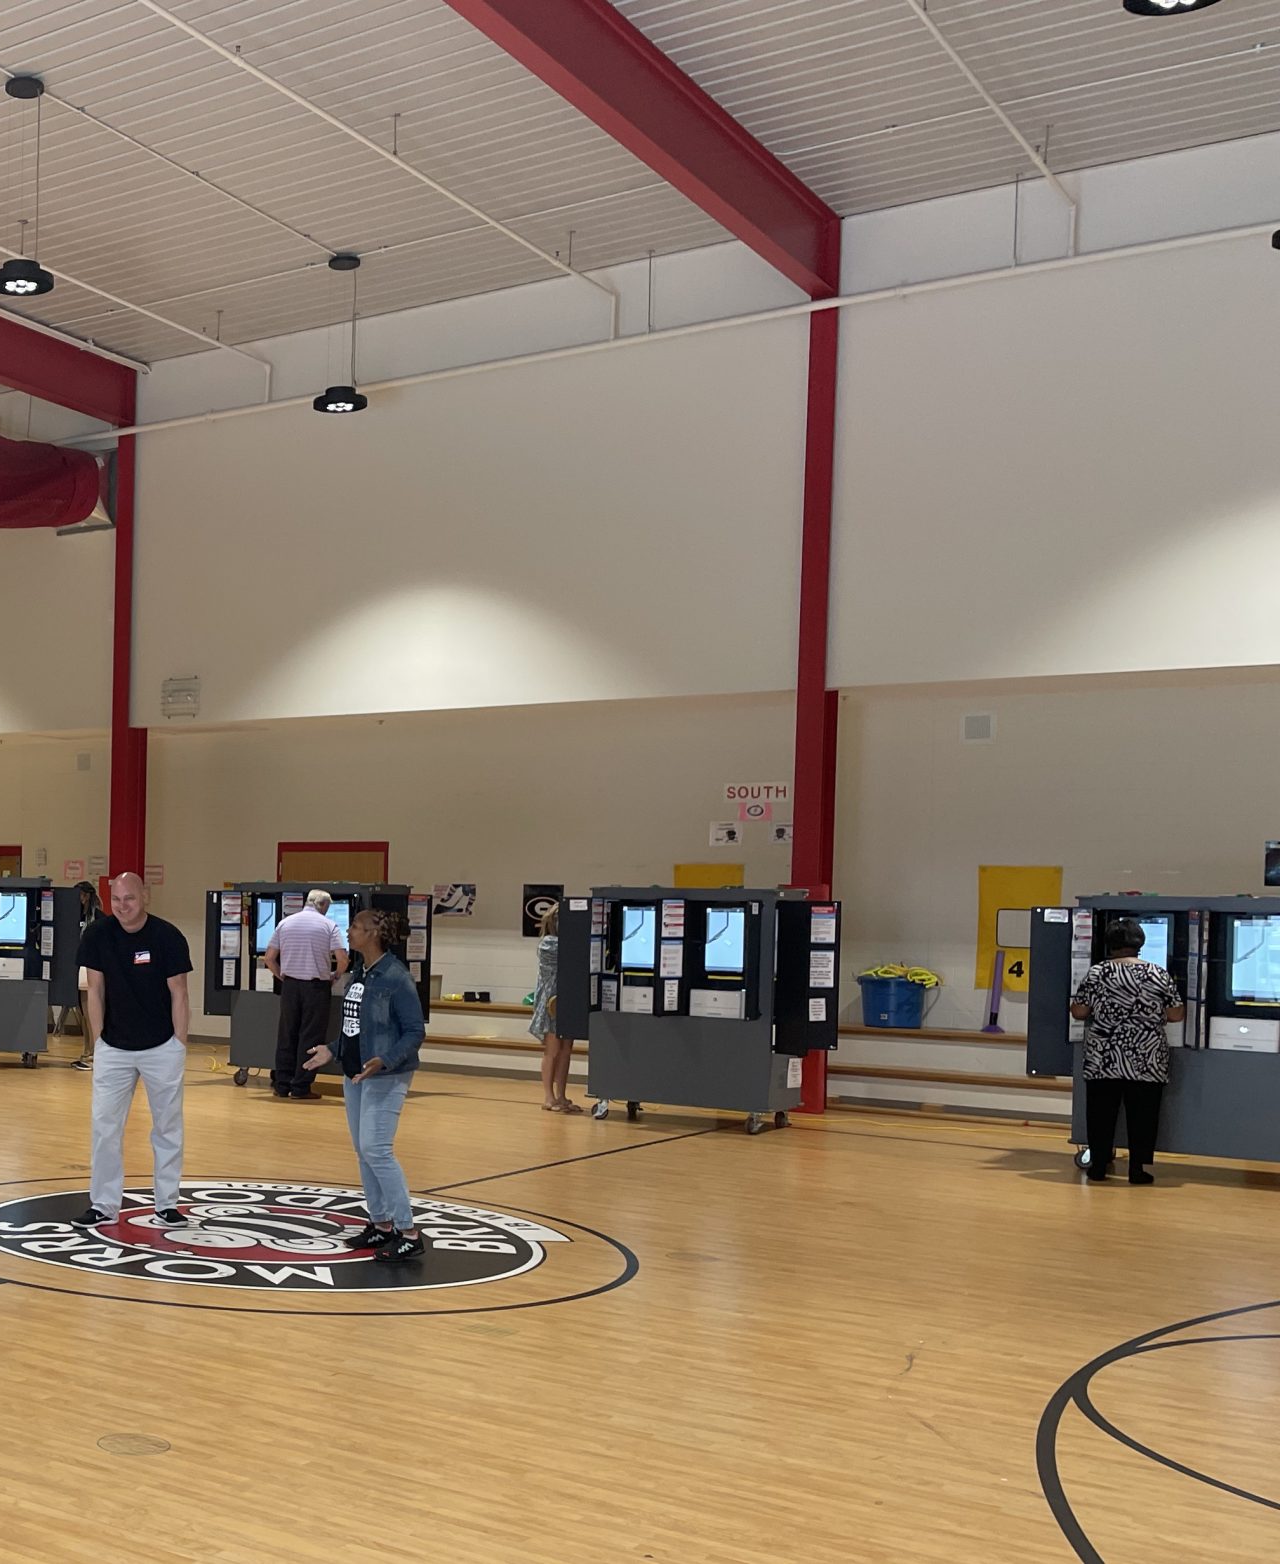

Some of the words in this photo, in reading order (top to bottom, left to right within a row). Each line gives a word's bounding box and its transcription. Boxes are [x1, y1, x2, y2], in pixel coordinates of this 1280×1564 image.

[726, 786, 787, 799] SOUTH
[1008, 961, 1024, 978] 4
[417, 1200, 503, 1221] WORL
[504, 1222, 541, 1231] IB
